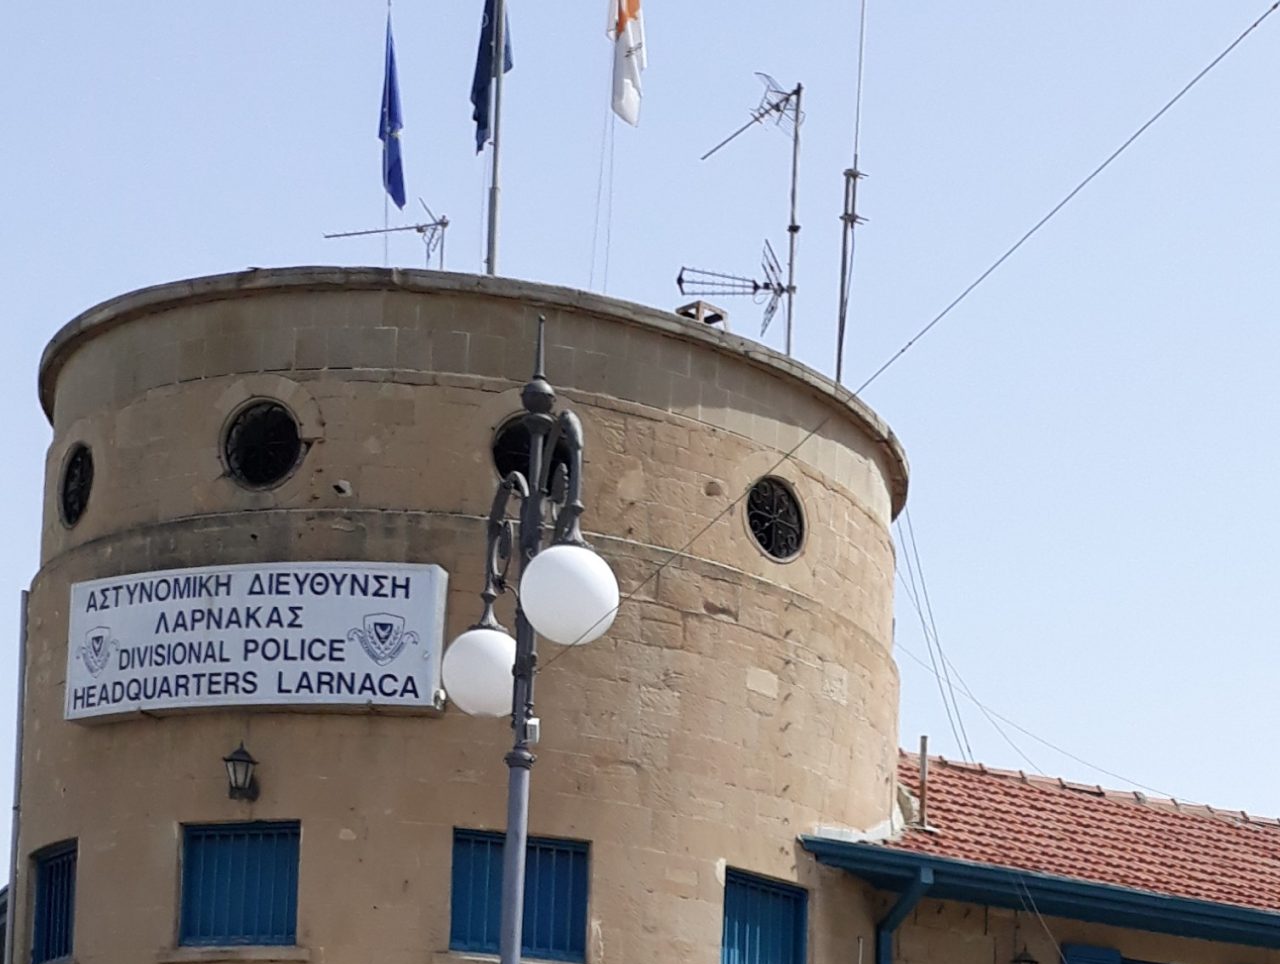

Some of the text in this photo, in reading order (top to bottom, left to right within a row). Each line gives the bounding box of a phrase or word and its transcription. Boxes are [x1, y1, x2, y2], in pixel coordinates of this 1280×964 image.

[86, 572, 411, 613] ΑΣΤΥΝΟΜΙΚΗ ΔΙΕΥΘΥΝΣΗ
[155, 606, 304, 635] ΛΑΡΝΑΚΑΣ
[118, 638, 346, 671] DIVISIONAL POLICE
[73, 671, 420, 711] HEADQUARTERS LARNACA
